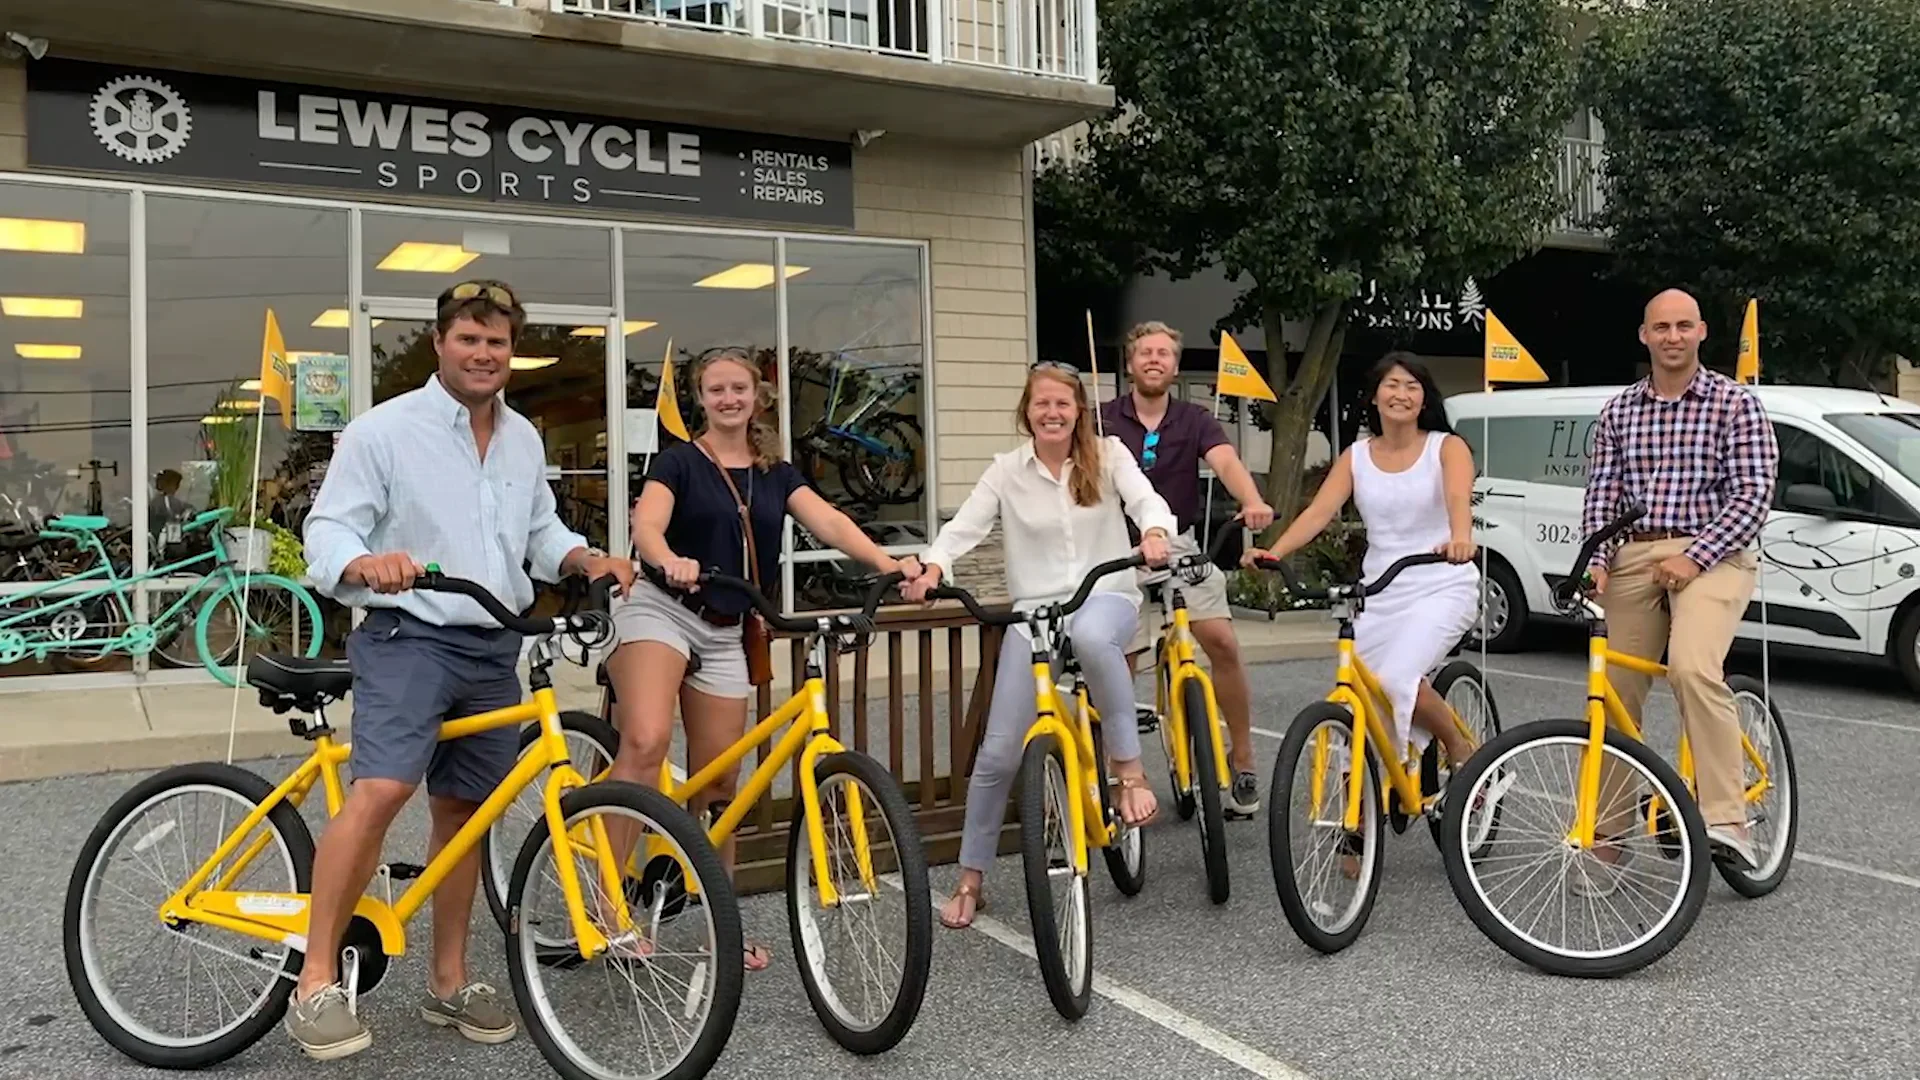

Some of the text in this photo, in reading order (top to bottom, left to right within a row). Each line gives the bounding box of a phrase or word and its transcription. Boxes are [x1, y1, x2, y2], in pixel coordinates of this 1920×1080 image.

[258, 90, 701, 177] LEWES CYCLE
[751, 149, 829, 171] RENTALS
[377, 161, 591, 203] SPORTS
[753, 167, 808, 187] SALES
[753, 185, 824, 205] REPAIRS
[1543, 463, 1587, 477] INSPI
